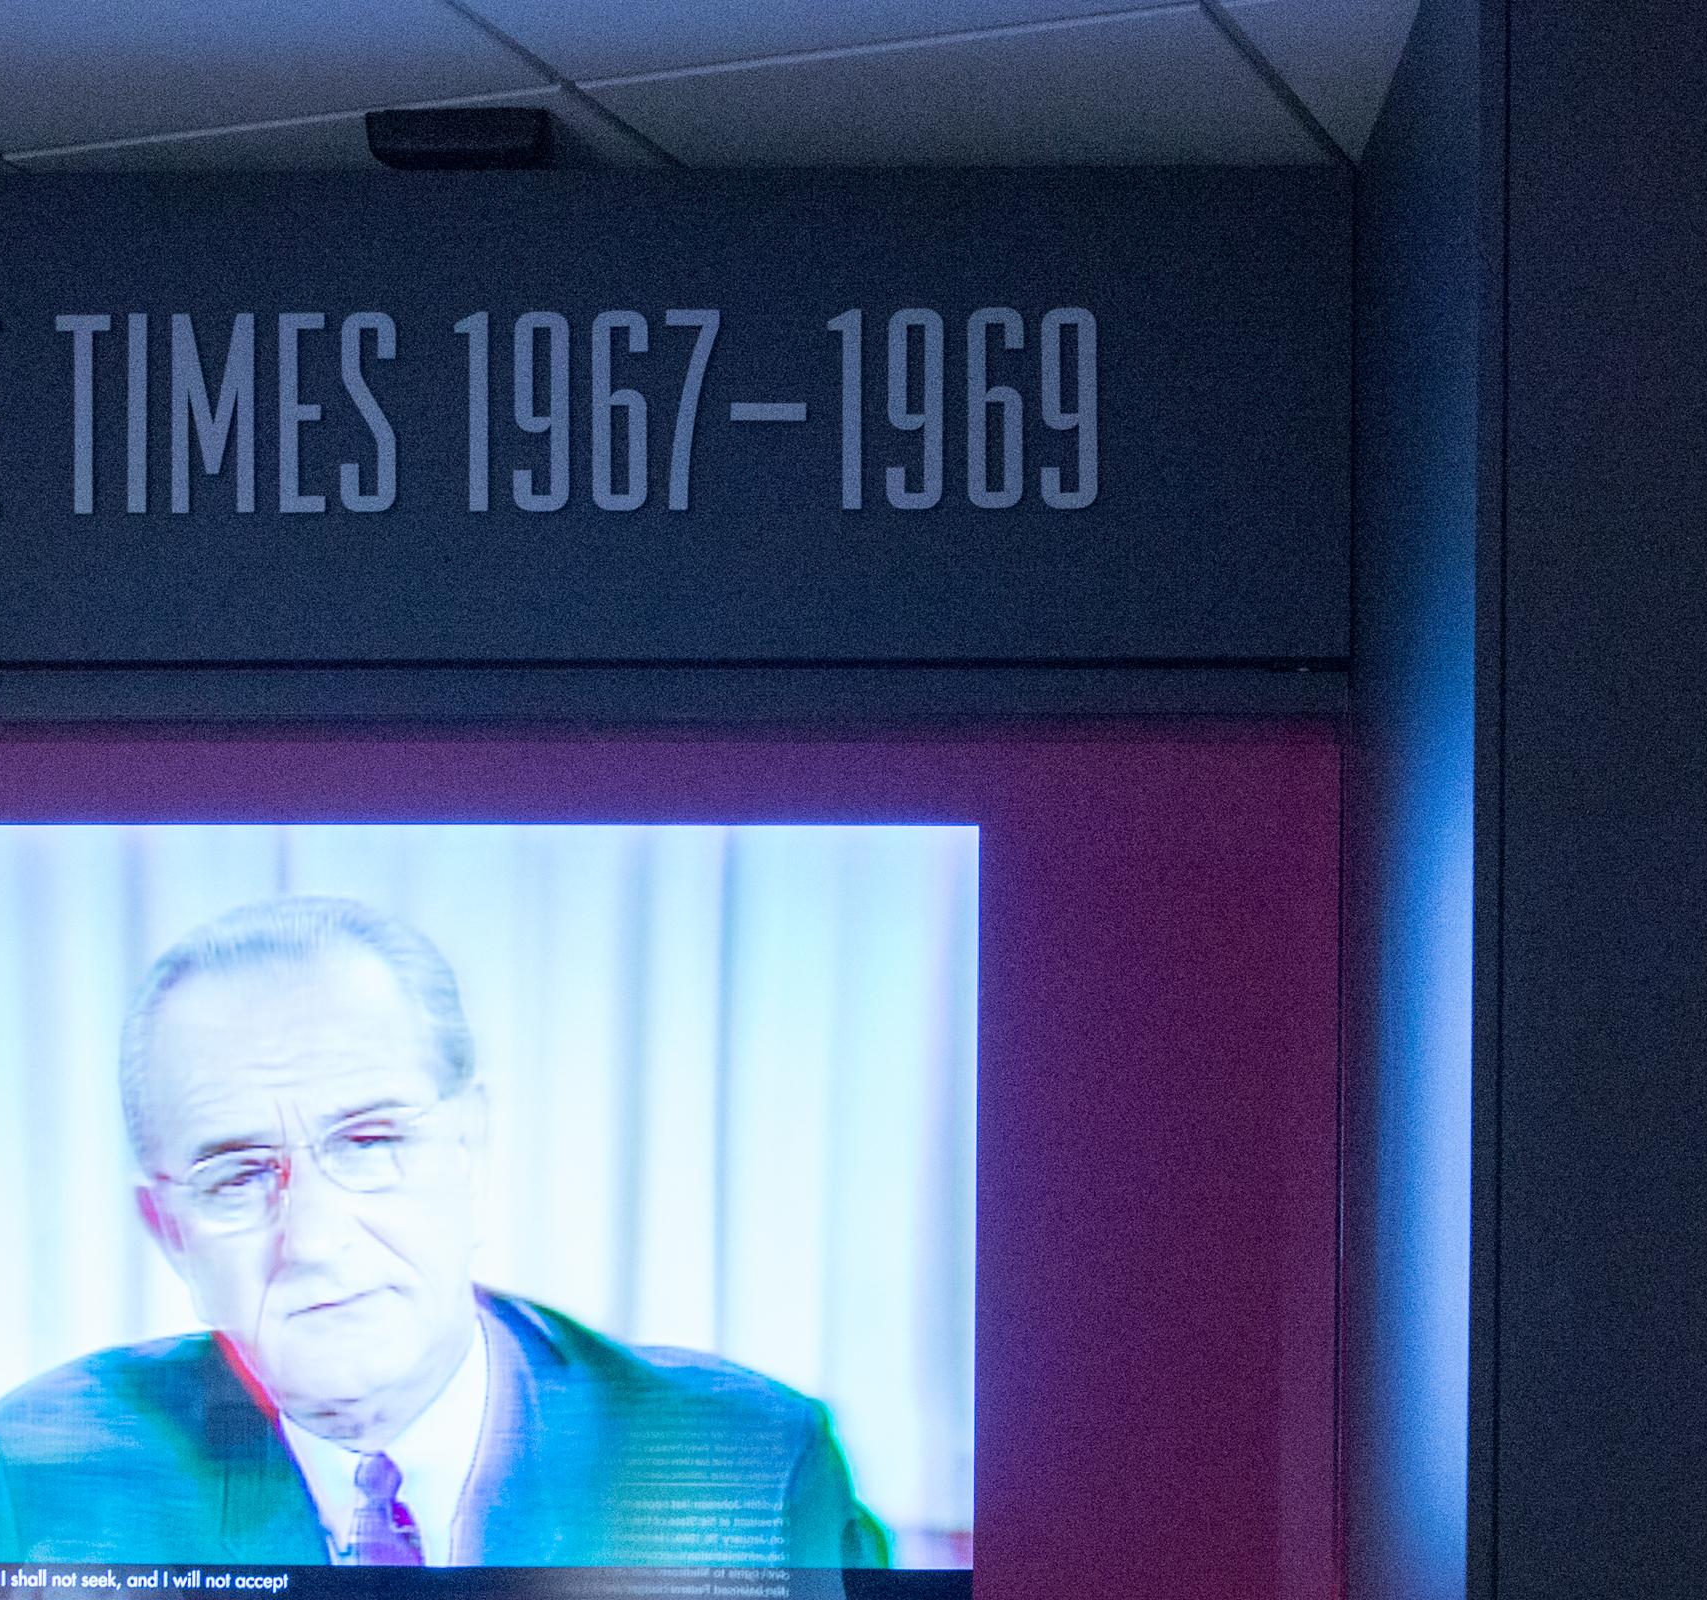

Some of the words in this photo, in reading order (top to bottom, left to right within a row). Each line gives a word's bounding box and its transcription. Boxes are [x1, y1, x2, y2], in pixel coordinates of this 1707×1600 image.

[56, 310, 398, 515] TIMES
[0, 1571, 6, 1588] I
[10, 1571, 46, 1589] shall
[51, 1573, 77, 1589] not
[82, 1572, 122, 1591] seek,
[126, 1572, 157, 1589] and
[162, 1572, 168, 1589] I
[172, 1572, 200, 1589] will
[206, 1574, 232, 1590] not
[236, 1574, 289, 1593] accept
